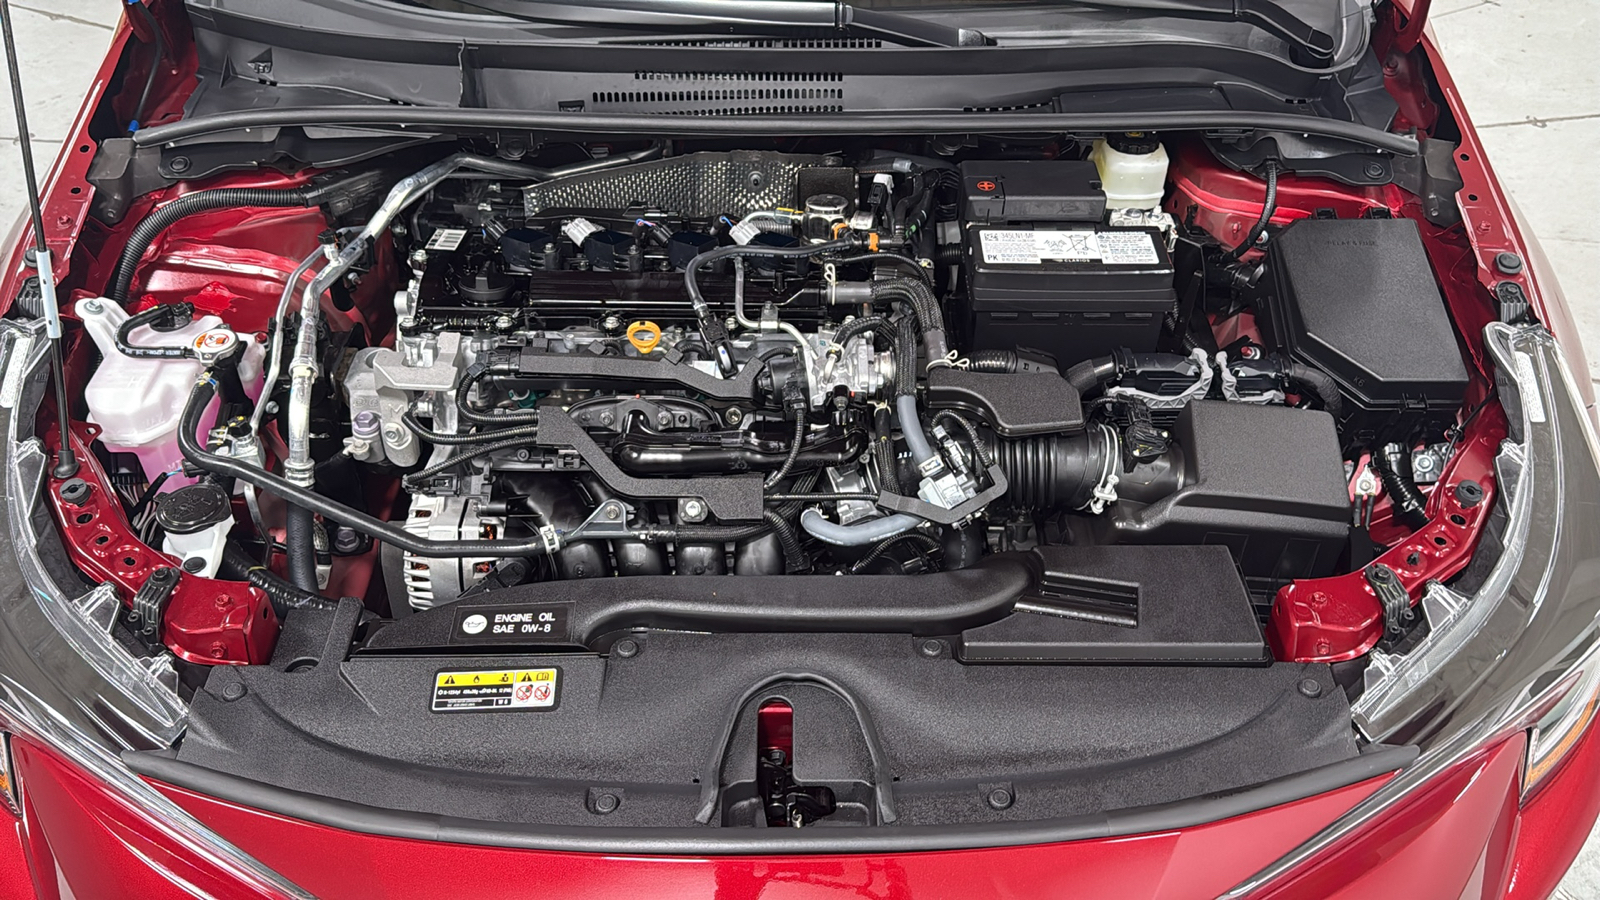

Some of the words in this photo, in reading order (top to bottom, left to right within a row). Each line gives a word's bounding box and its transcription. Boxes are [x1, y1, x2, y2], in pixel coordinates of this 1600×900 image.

[494, 612, 533, 623] ENGINE
[538, 612, 556, 622] OIL
[492, 624, 515, 634] SAE
[521, 623, 552, 633] 0W-8
